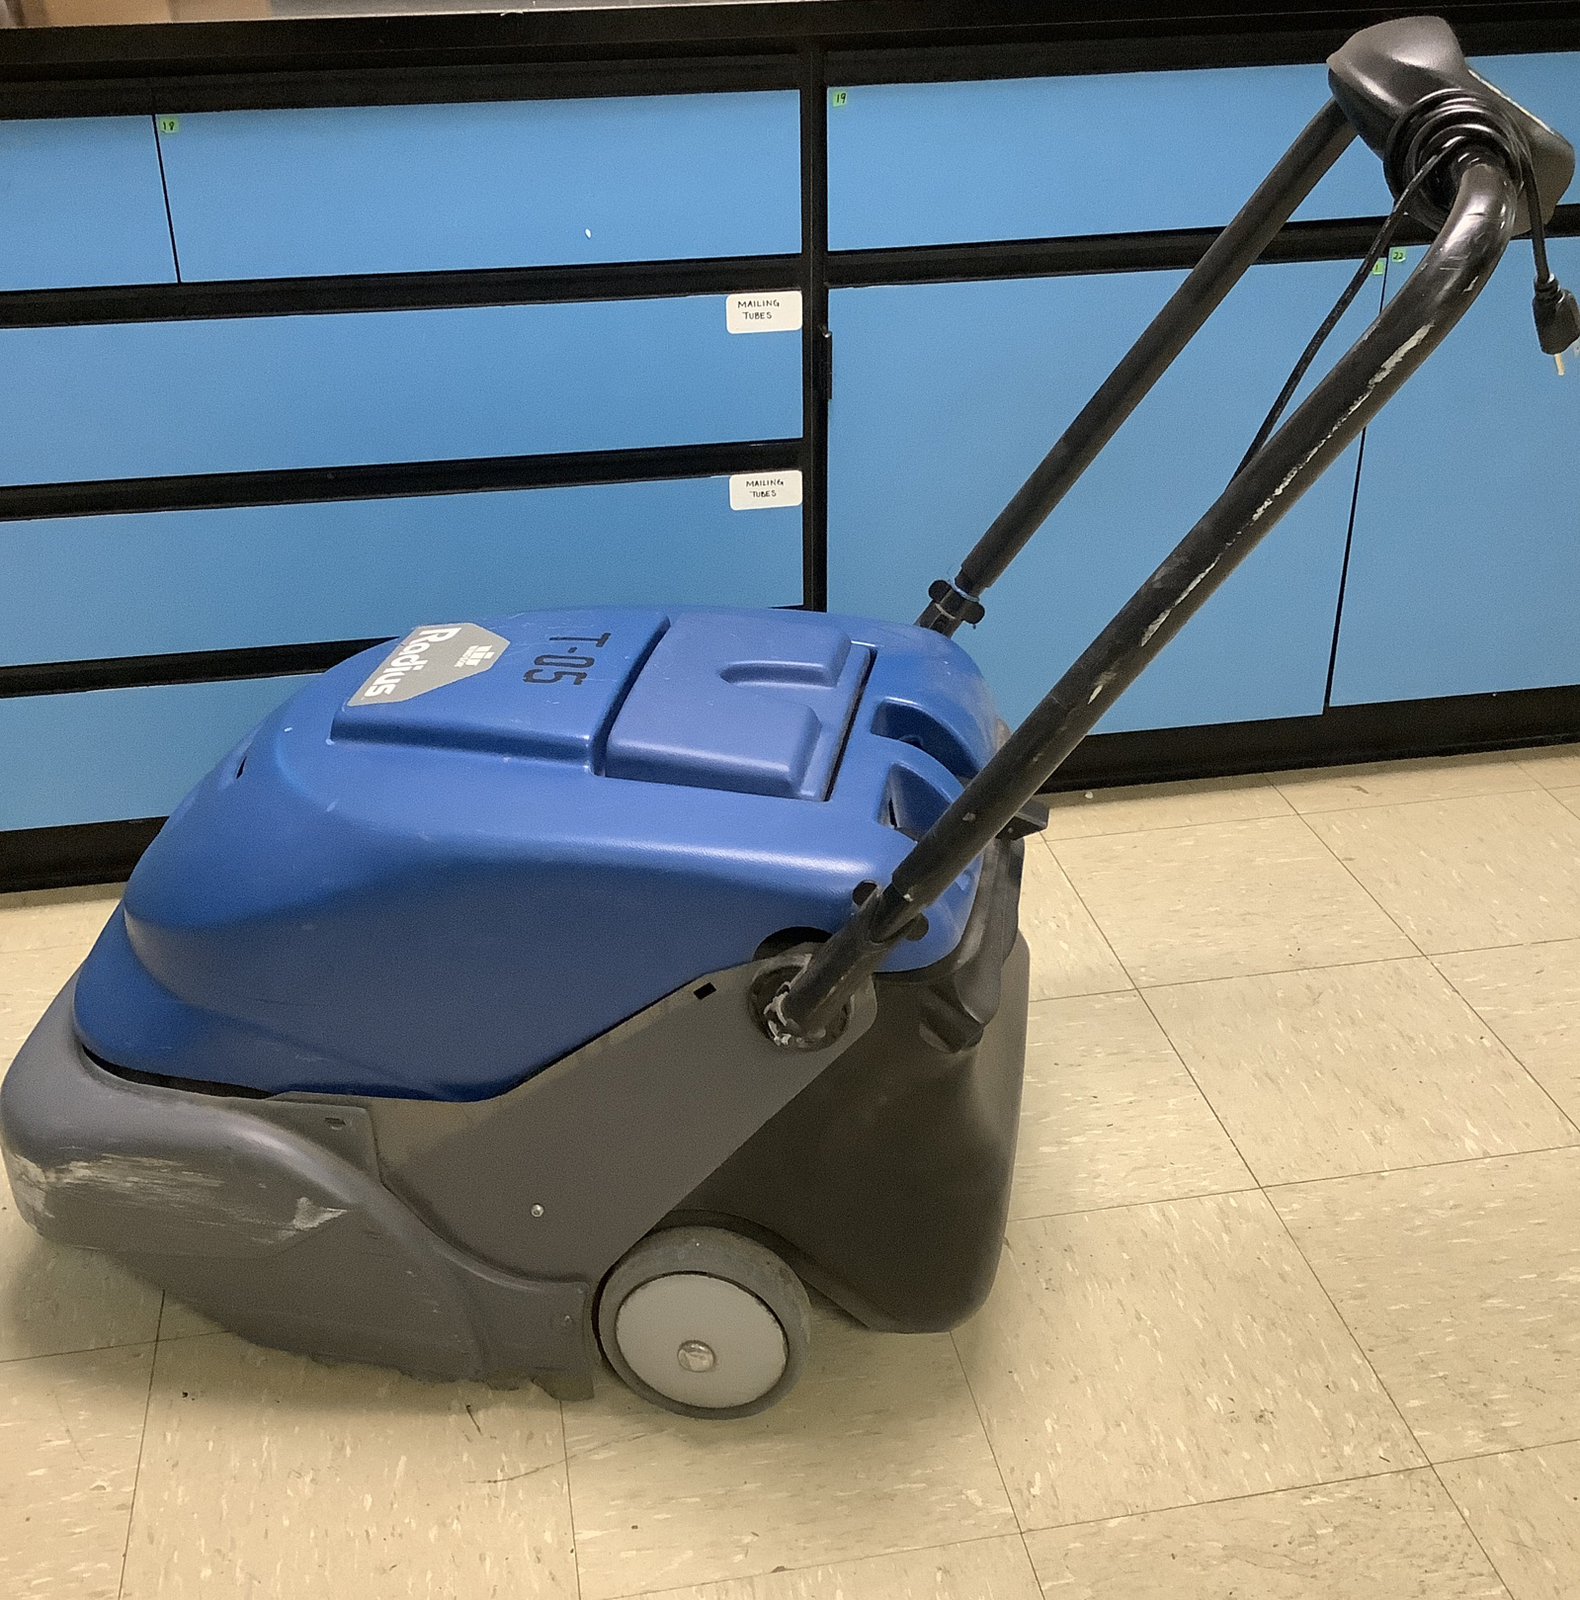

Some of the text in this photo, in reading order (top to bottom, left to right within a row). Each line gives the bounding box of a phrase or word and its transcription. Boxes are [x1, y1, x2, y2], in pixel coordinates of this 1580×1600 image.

[836, 92, 847, 104] 19
[1392, 251, 1404, 260] 22
[737, 299, 780, 309] MAILING
[742, 311, 773, 320] TUBES
[745, 478, 784, 487] MAILING
[749, 489, 777, 498] TUBES
[364, 627, 462, 697] Radius
[522, 632, 612, 686] T-05
